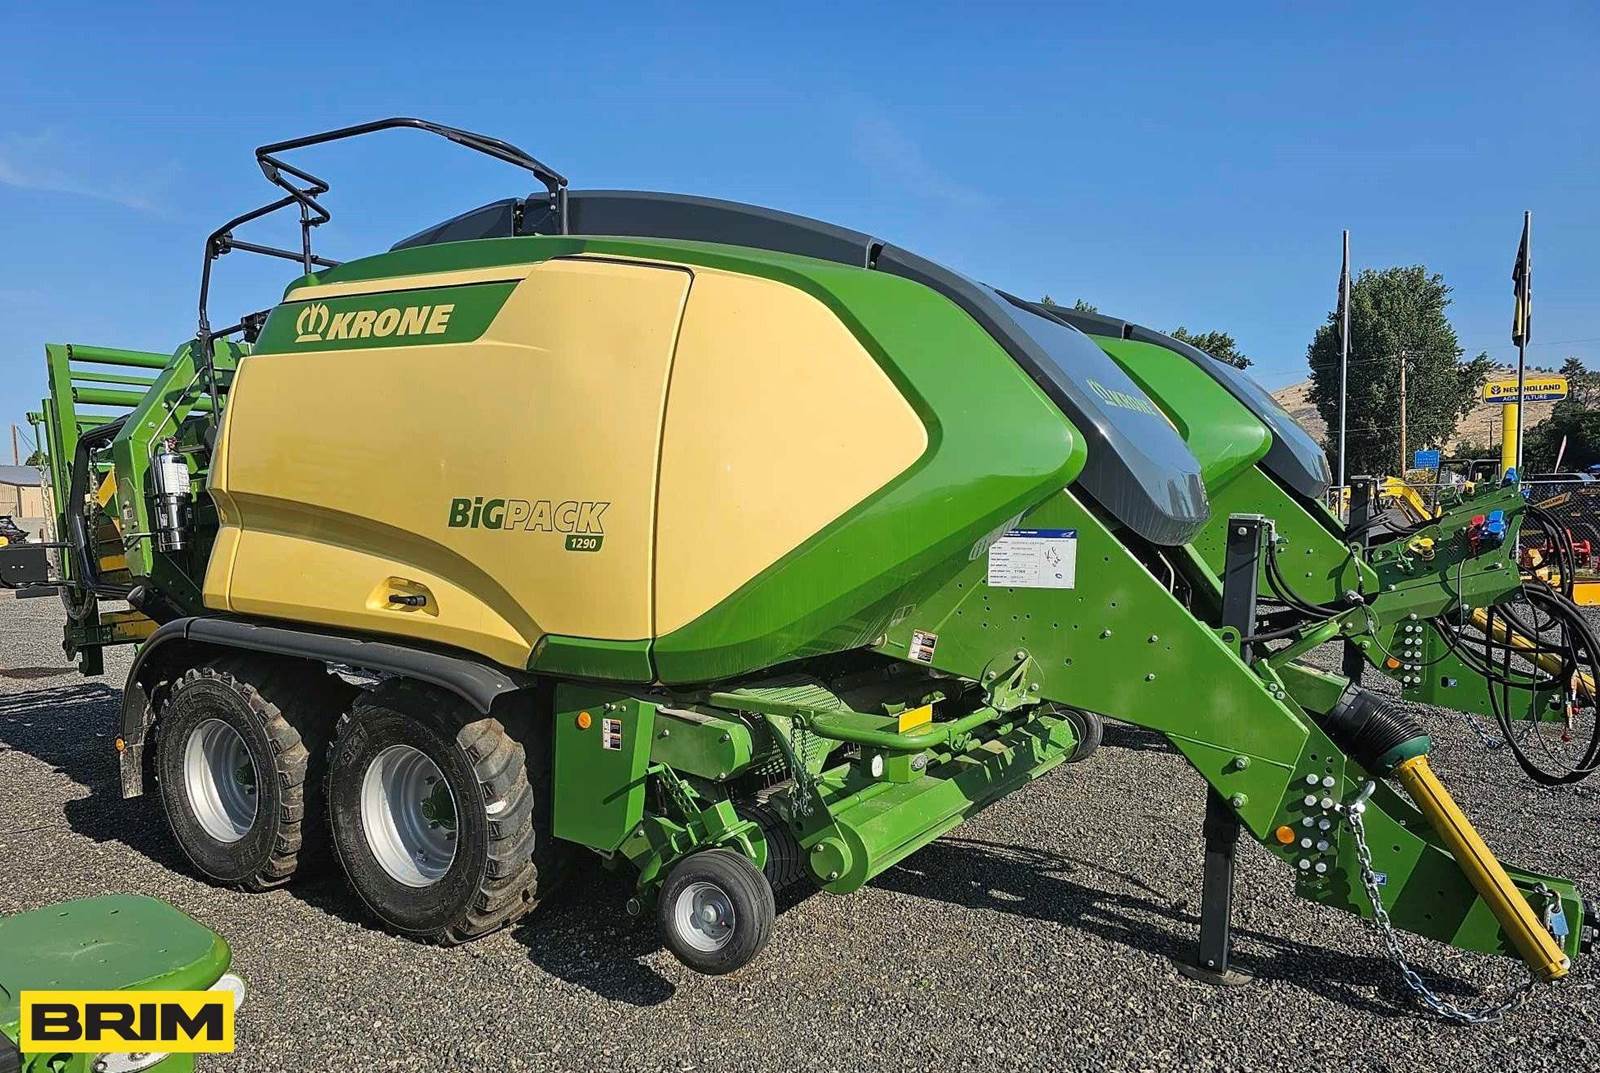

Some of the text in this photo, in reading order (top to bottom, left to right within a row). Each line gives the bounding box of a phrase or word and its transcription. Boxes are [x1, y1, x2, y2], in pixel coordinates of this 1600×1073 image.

[325, 303, 455, 340] KRONE
[1523, 384, 1561, 392] HOLLAND
[571, 538, 597, 549] 1290
